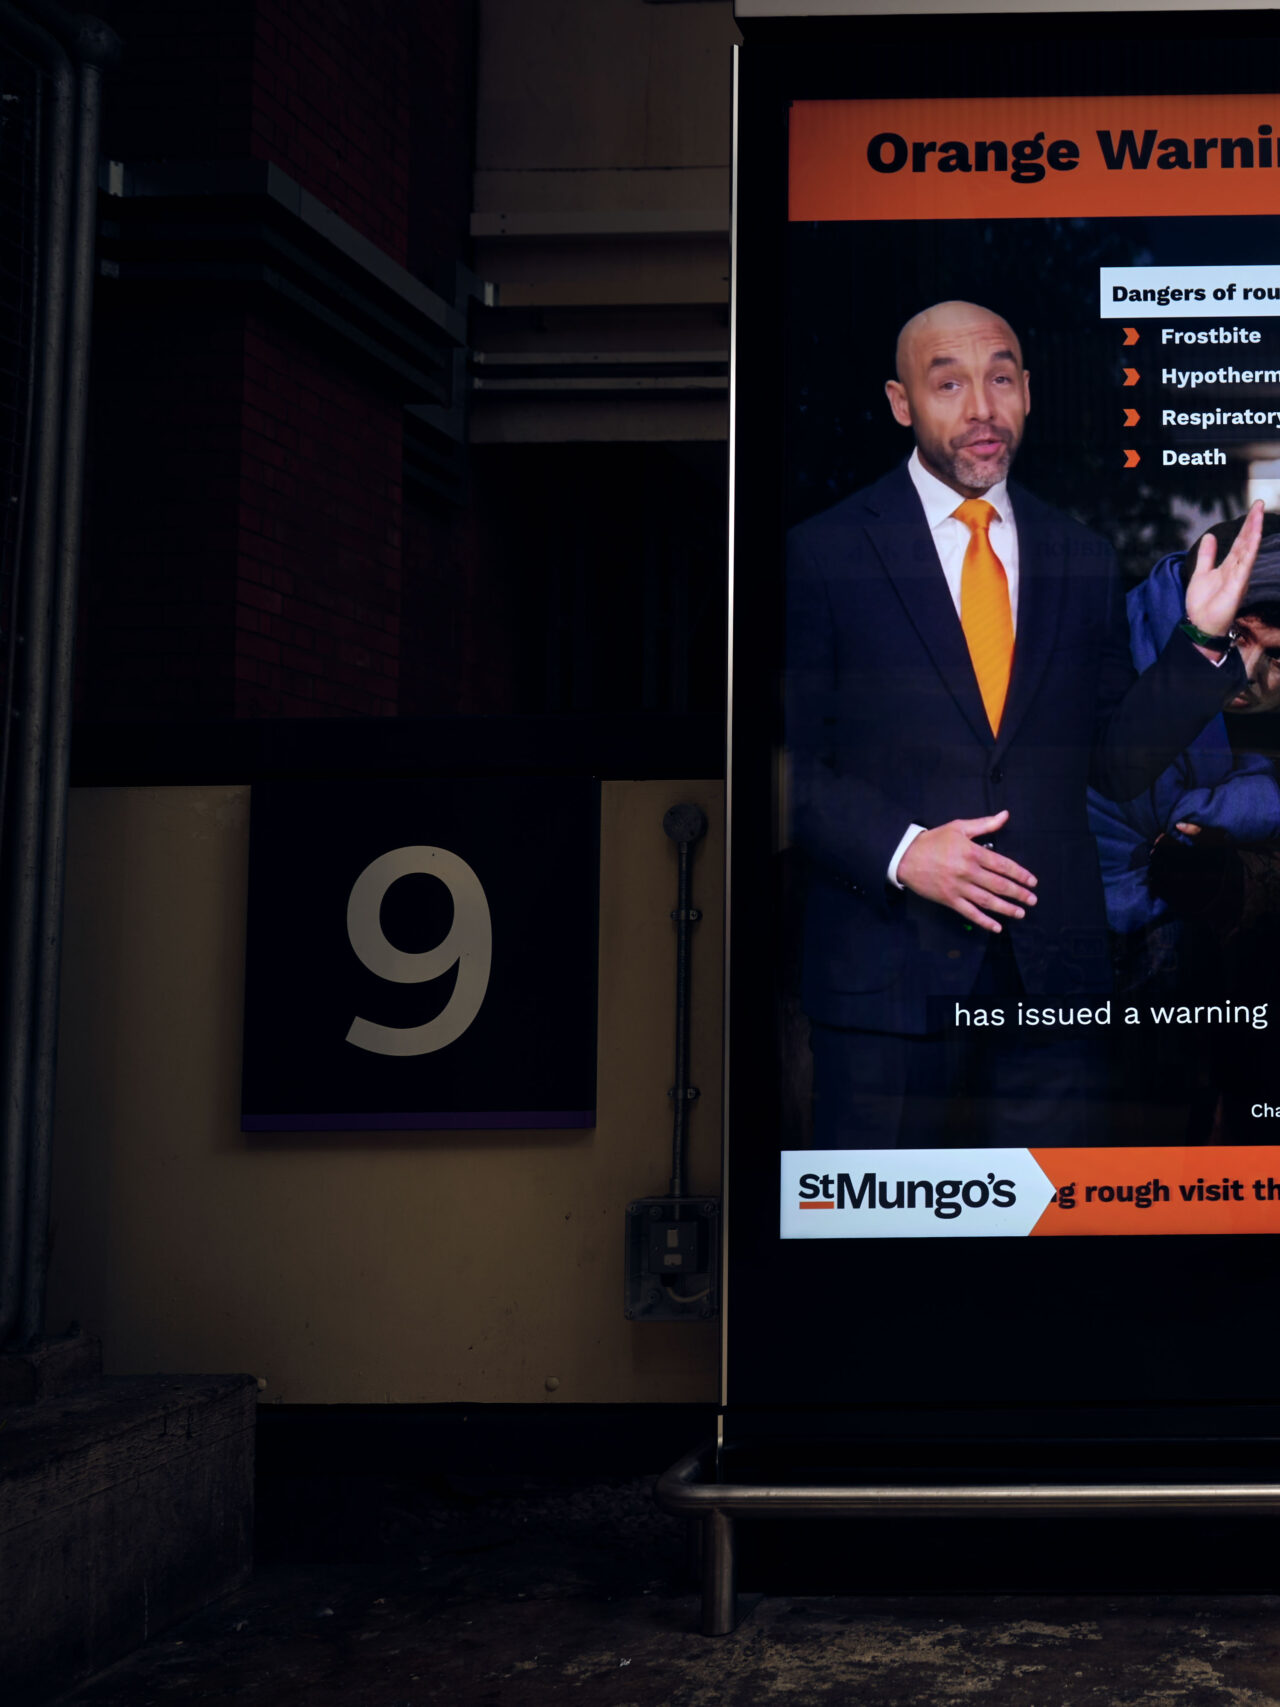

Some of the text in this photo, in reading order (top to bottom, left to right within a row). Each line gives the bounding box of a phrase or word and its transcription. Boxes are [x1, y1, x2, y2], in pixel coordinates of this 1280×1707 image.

[866, 132, 1080, 184] Orange
[1112, 285, 1207, 307] Dangers
[1212, 283, 1237, 301] of
[1161, 326, 1262, 345] Frostbite
[1162, 447, 1228, 466] Death
[346, 845, 493, 1057] 9
[955, 999, 1269, 1030] has issued a warning
[1050, 1182, 1076, 1210] g
[1085, 1178, 1170, 1209] rough
[1178, 1177, 1245, 1202] visit
